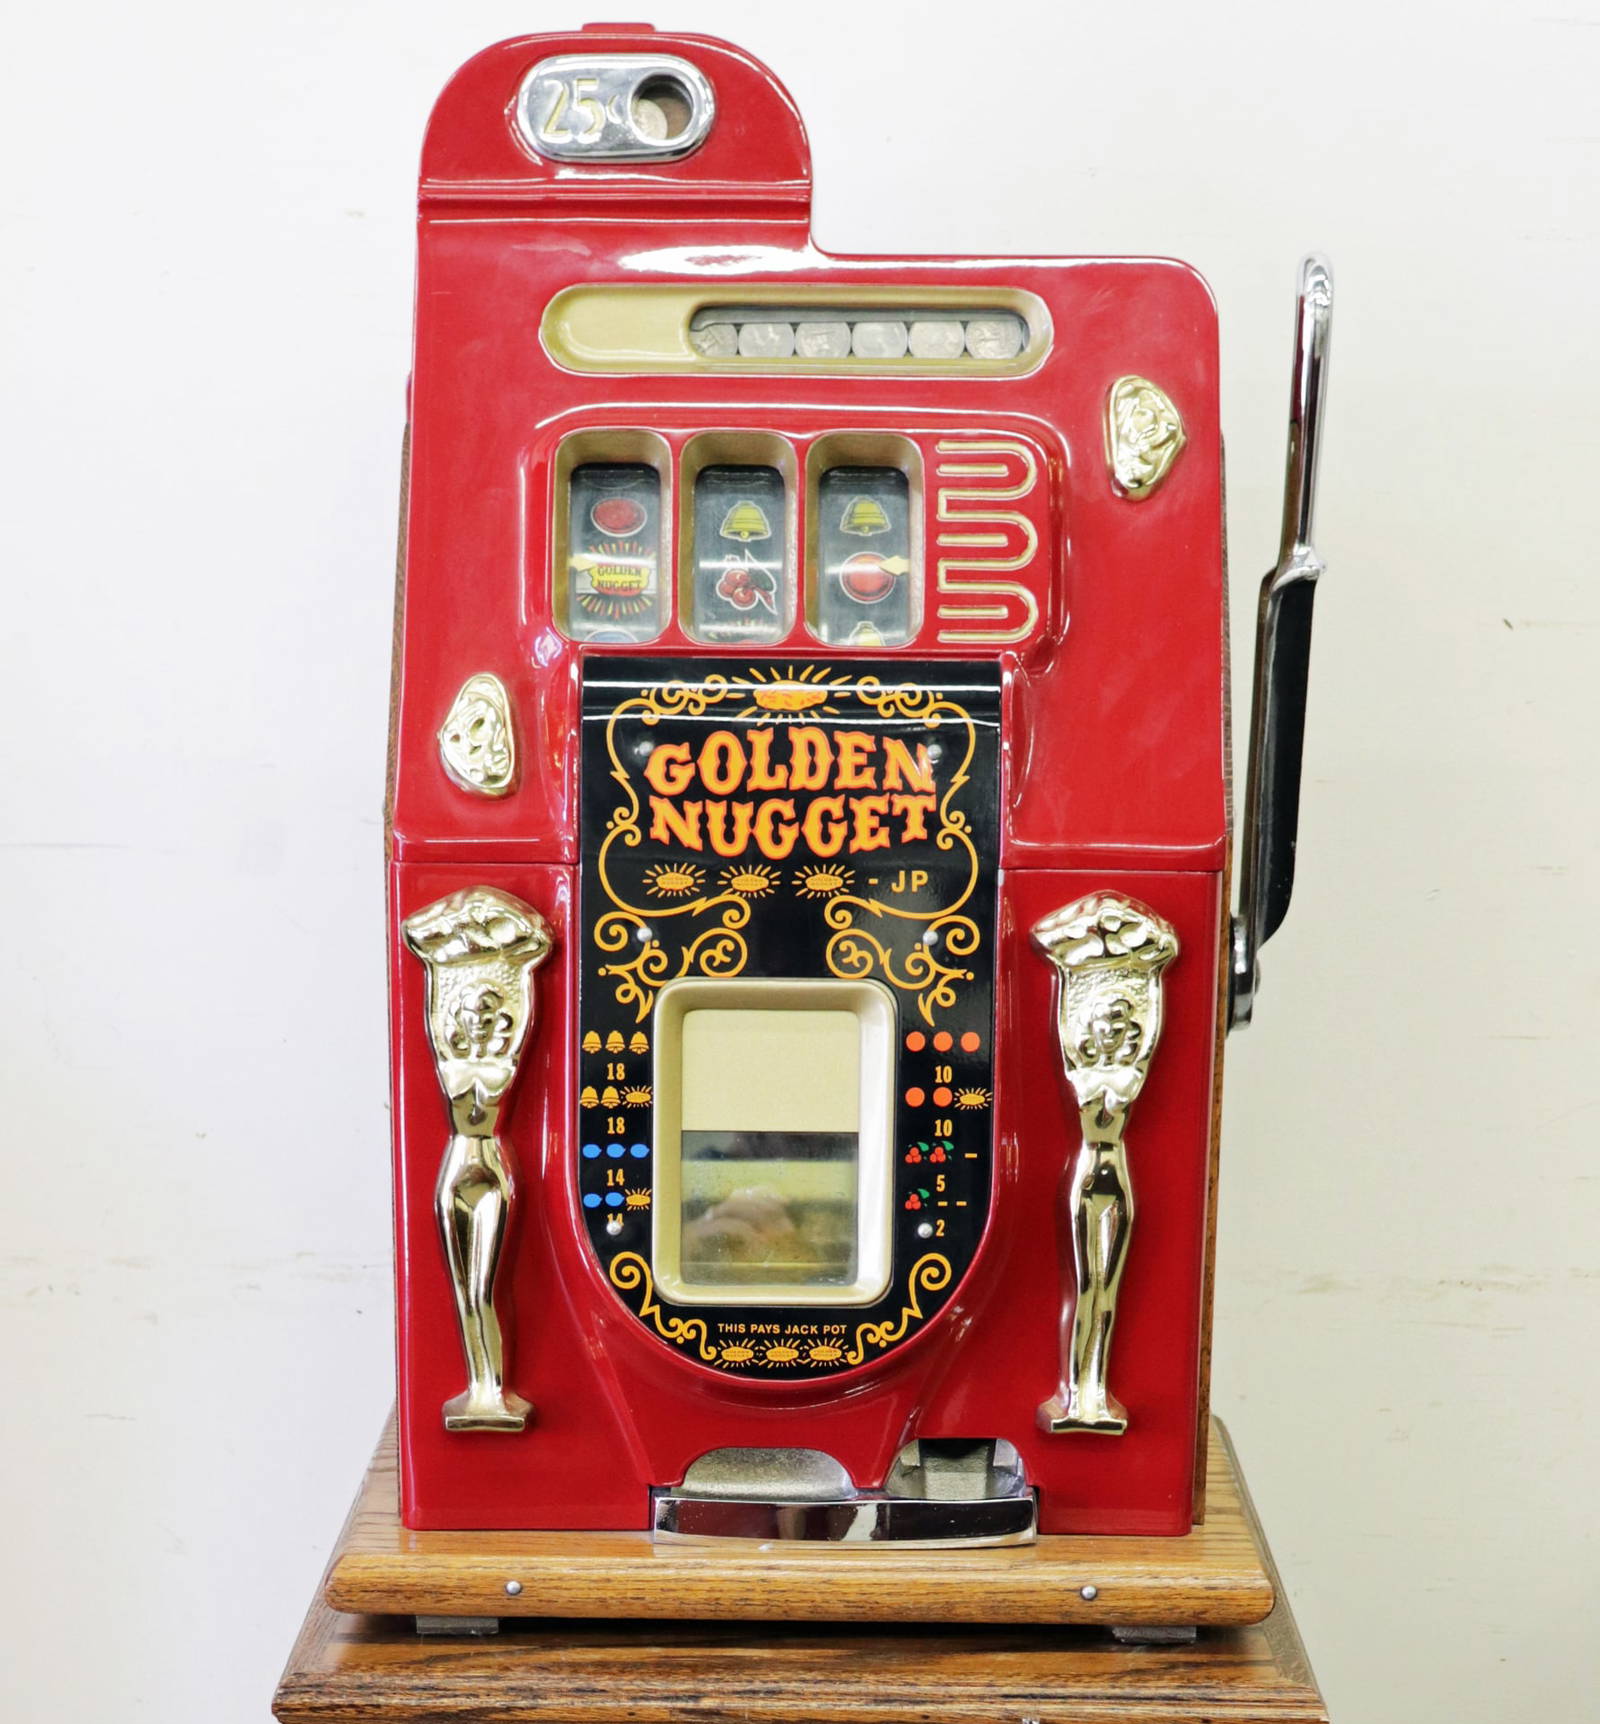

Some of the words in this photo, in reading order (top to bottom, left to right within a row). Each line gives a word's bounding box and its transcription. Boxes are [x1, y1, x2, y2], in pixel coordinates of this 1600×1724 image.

[643, 726, 936, 797] GOLDEN
[649, 792, 936, 860] NUGGET
[891, 870, 928, 893] JP
[606, 1063, 626, 1081] 18
[934, 1065, 953, 1083] 10
[606, 1117, 626, 1135] 18
[934, 1119, 953, 1137] 10
[606, 1168, 625, 1186] 14
[936, 1174, 945, 1192] 5
[935, 1219, 945, 1237] 2
[717, 1323, 746, 1334] THIS
[750, 1323, 780, 1335] PAYS
[784, 1324, 818, 1335] JACK
[823, 1324, 848, 1335] POT
